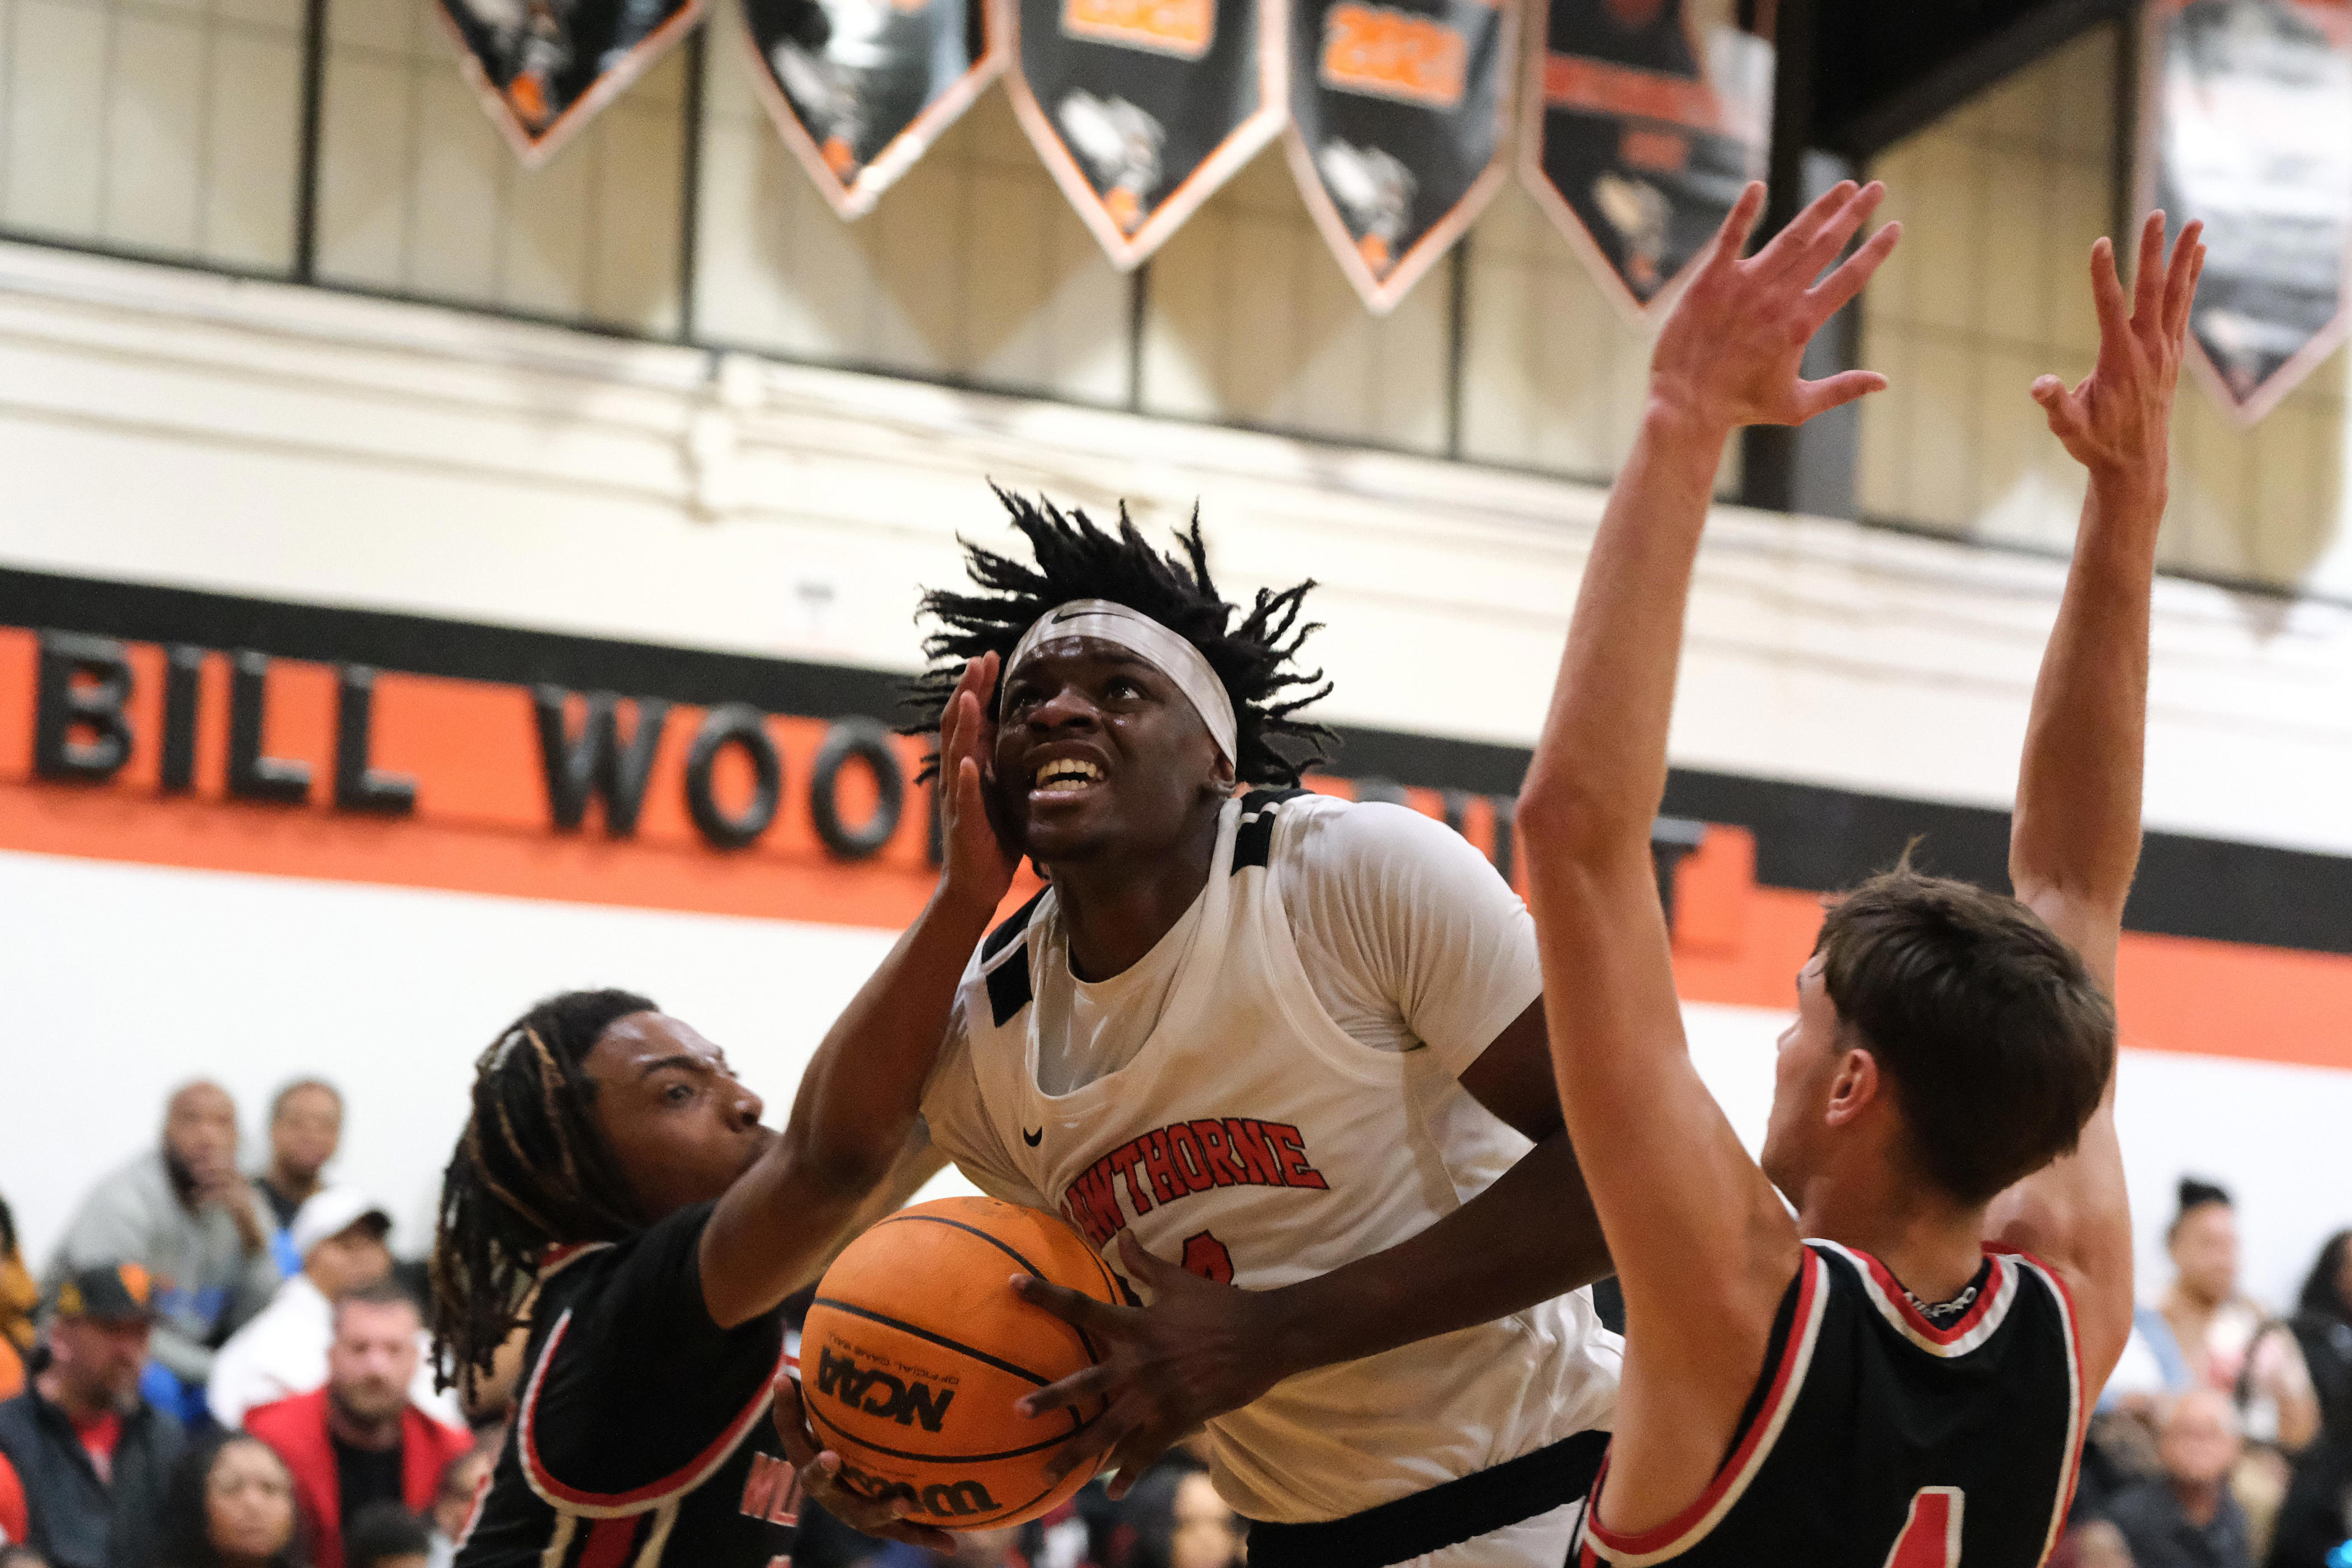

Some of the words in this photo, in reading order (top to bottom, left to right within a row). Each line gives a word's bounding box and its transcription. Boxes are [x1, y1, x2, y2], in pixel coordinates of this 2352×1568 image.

[35, 627, 417, 813] BILL
[533, 683, 942, 869] WOO
[1061, 1117, 1330, 1248] AWTHORNE
[818, 1345, 955, 1432] NCAA
